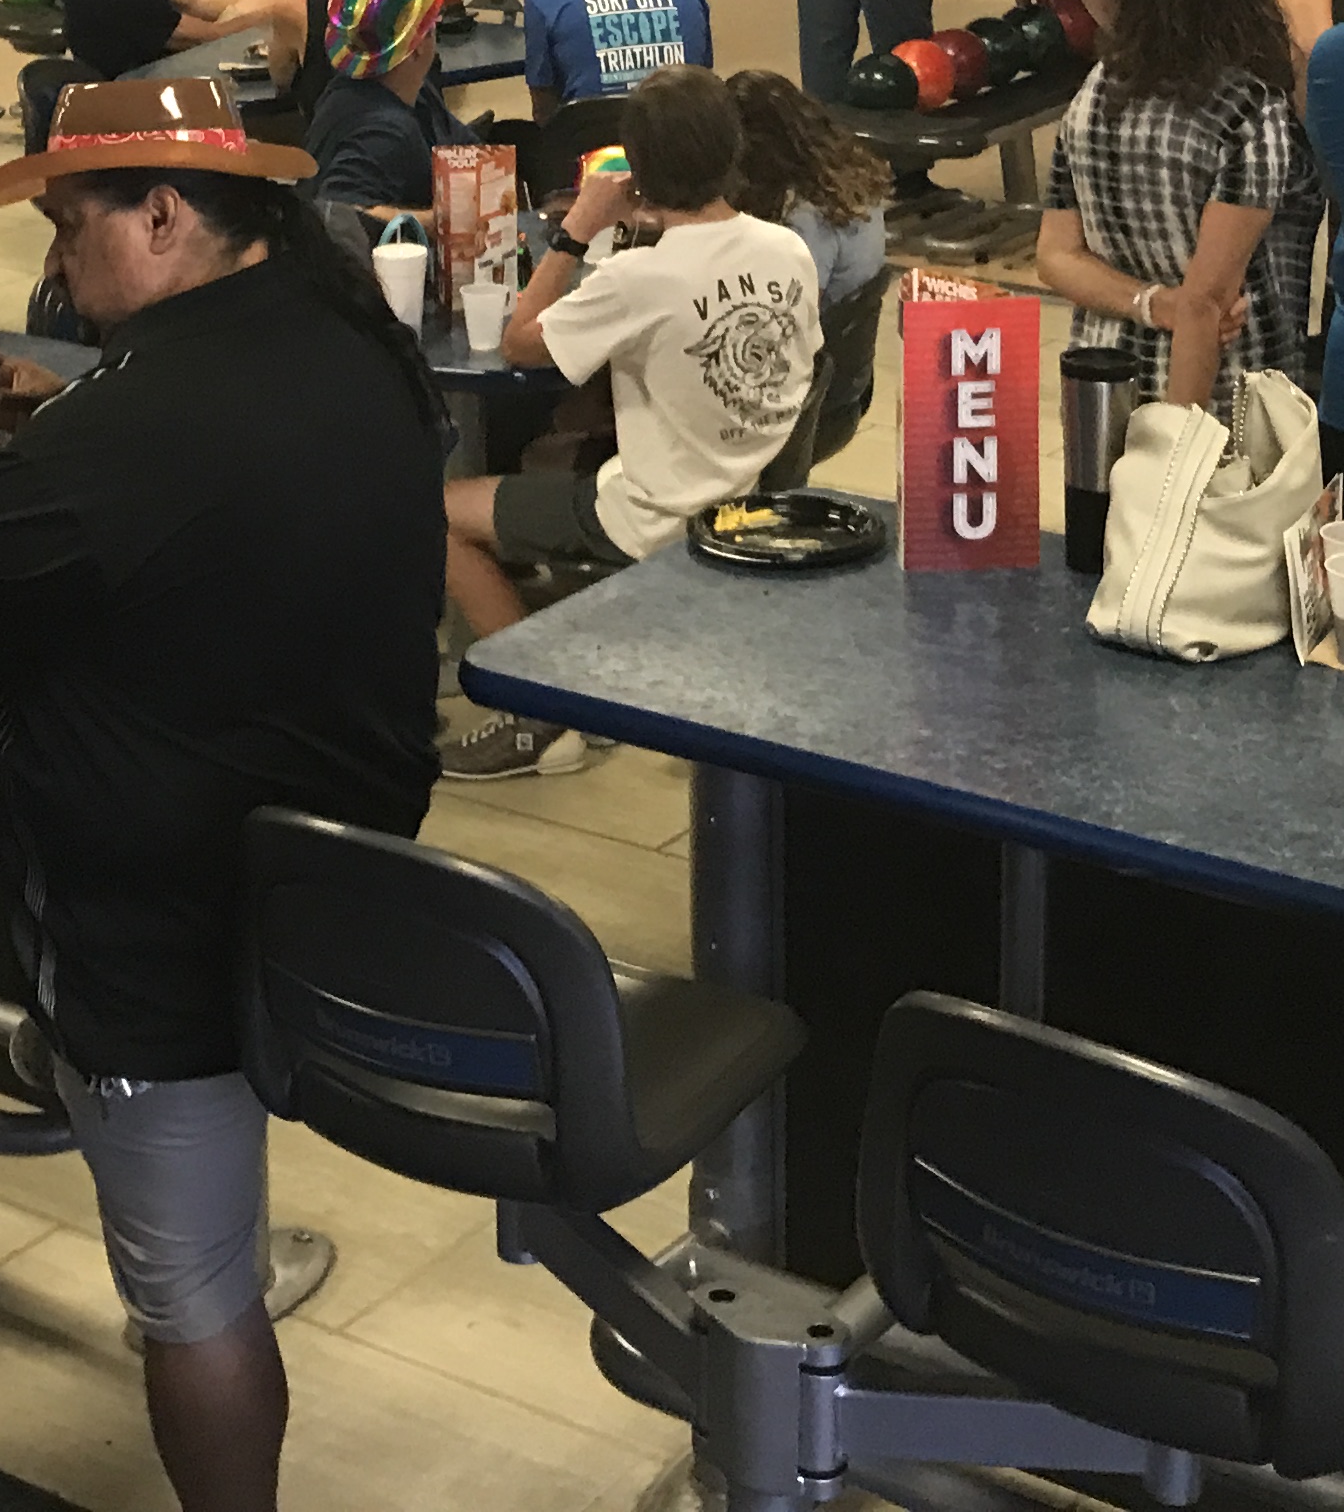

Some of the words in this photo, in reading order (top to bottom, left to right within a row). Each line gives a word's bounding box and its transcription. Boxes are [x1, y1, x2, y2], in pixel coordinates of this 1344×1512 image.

[596, 44, 685, 72] TRIATHLON
[693, 273, 783, 320] VANS
[951, 327, 1001, 539] MENU
